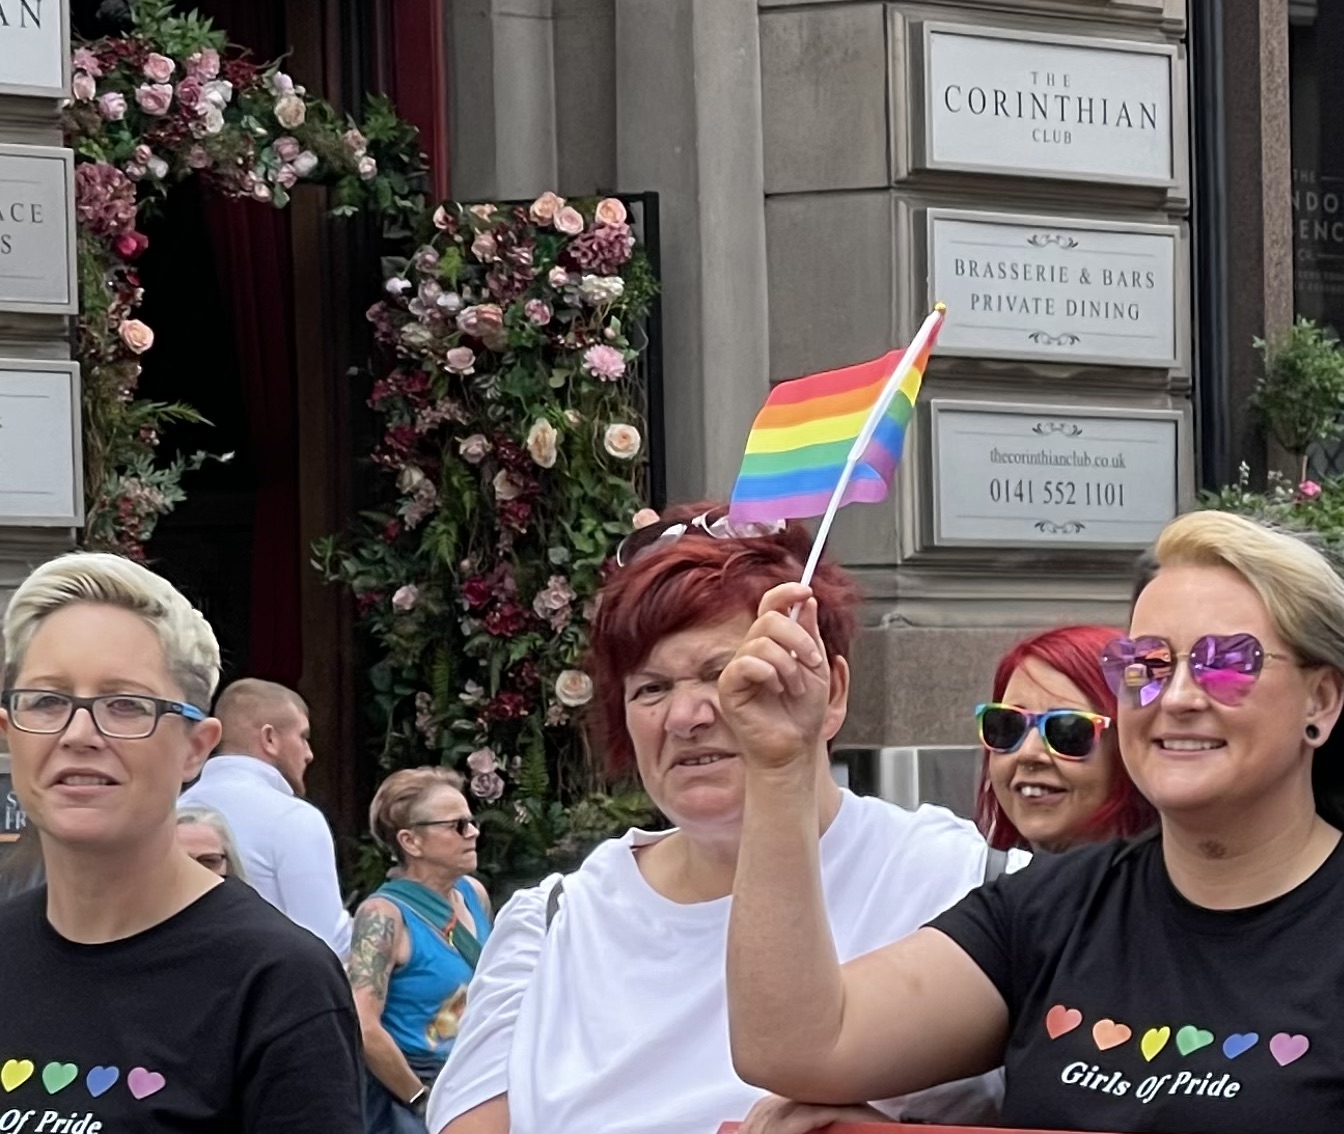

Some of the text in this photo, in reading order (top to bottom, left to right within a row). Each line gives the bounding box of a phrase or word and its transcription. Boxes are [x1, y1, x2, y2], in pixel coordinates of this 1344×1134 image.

[1030, 71, 1071, 88] THE
[944, 84, 1157, 130] CORINTHIAN
[1032, 128, 1072, 144] CLUB
[955, 258, 1155, 290] BRASSERIE & BARS
[970, 293, 1141, 321] PRIVATE DINING
[990, 448, 1126, 469] thecorinthianclub.co.uk
[990, 478, 1124, 507] 0141 552 1101
[1060, 1061, 1241, 1104] Girls Of Pride
